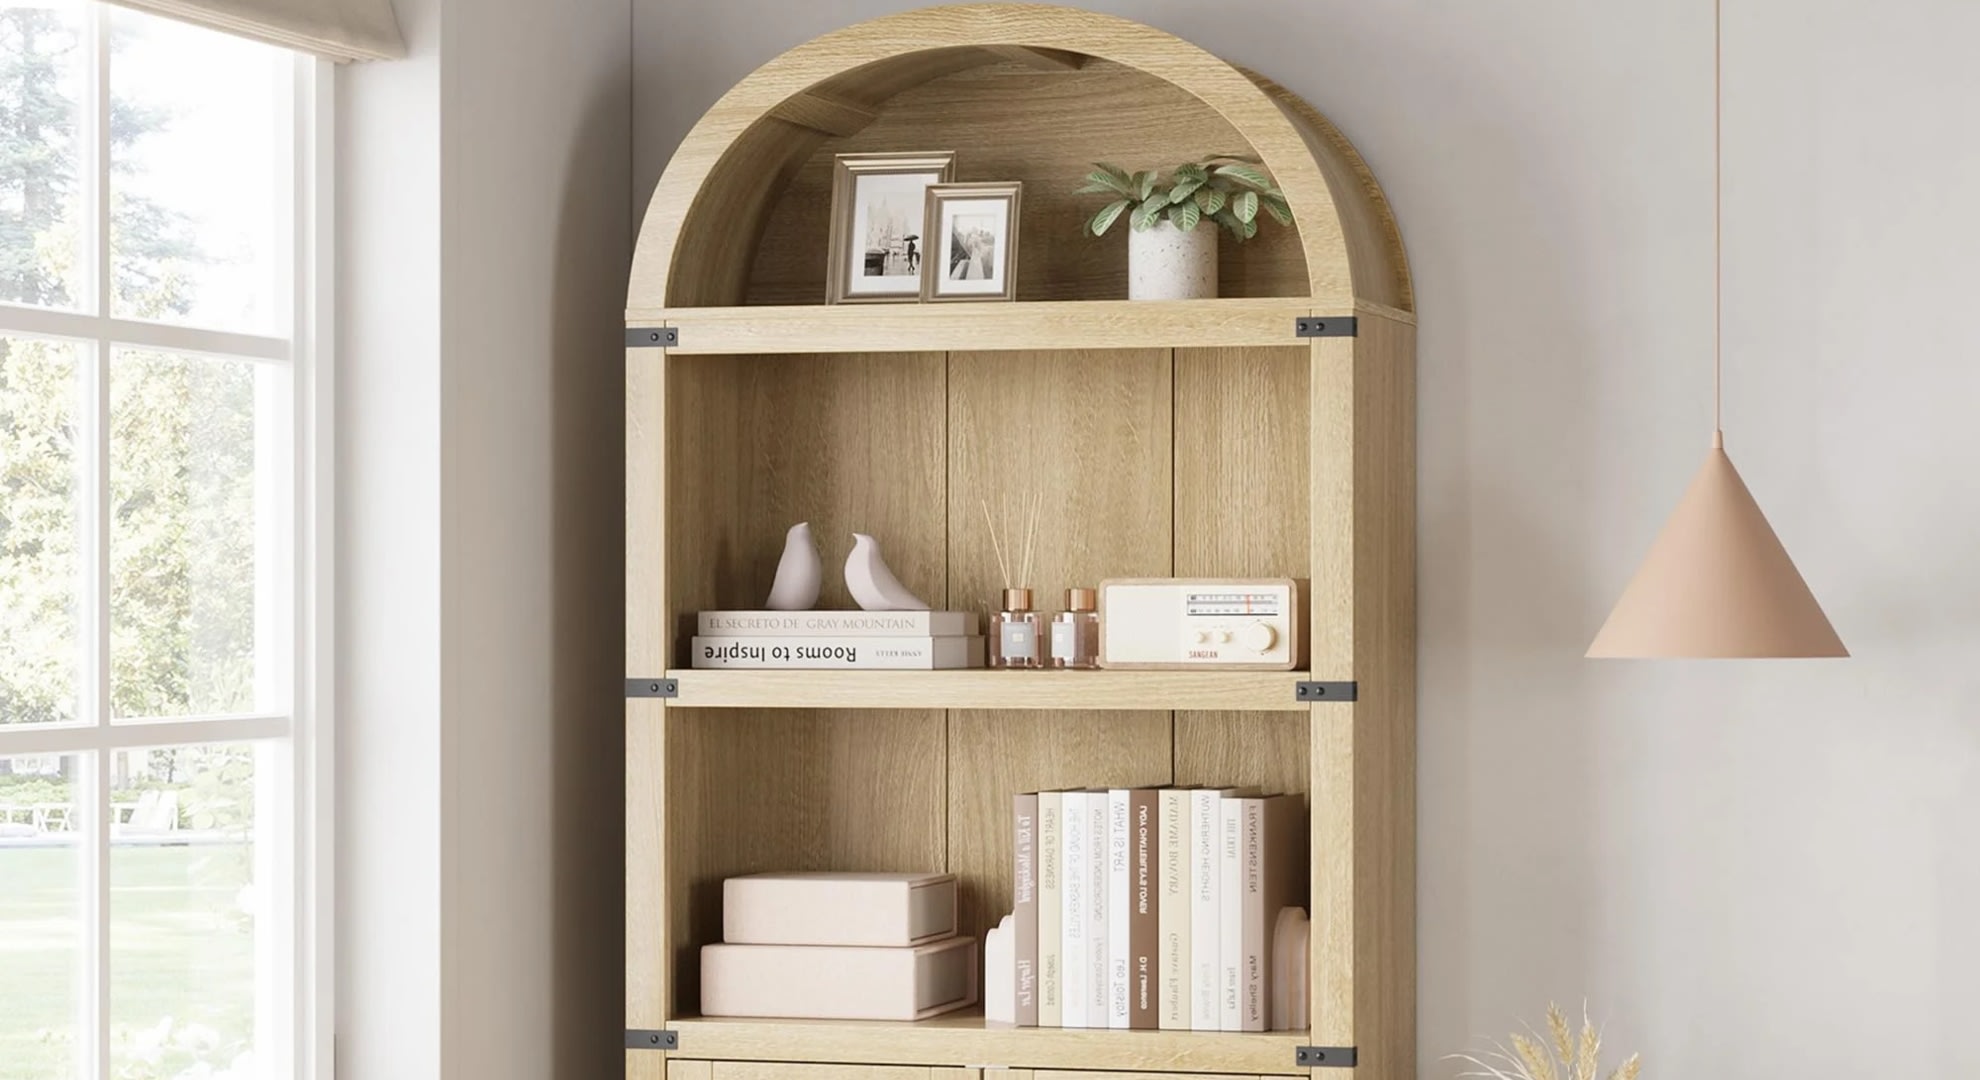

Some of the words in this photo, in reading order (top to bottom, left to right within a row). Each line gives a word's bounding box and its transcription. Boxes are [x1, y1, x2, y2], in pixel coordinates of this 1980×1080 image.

[709, 619, 723, 629] EL
[726, 619, 780, 629] SECRETO
[783, 619, 799, 629] DE
[806, 619, 838, 629] GRAY
[842, 619, 915, 629] MOUNTAIN
[705, 642, 765, 662] Inspire
[772, 648, 790, 660] to
[797, 647, 856, 662] Rooms
